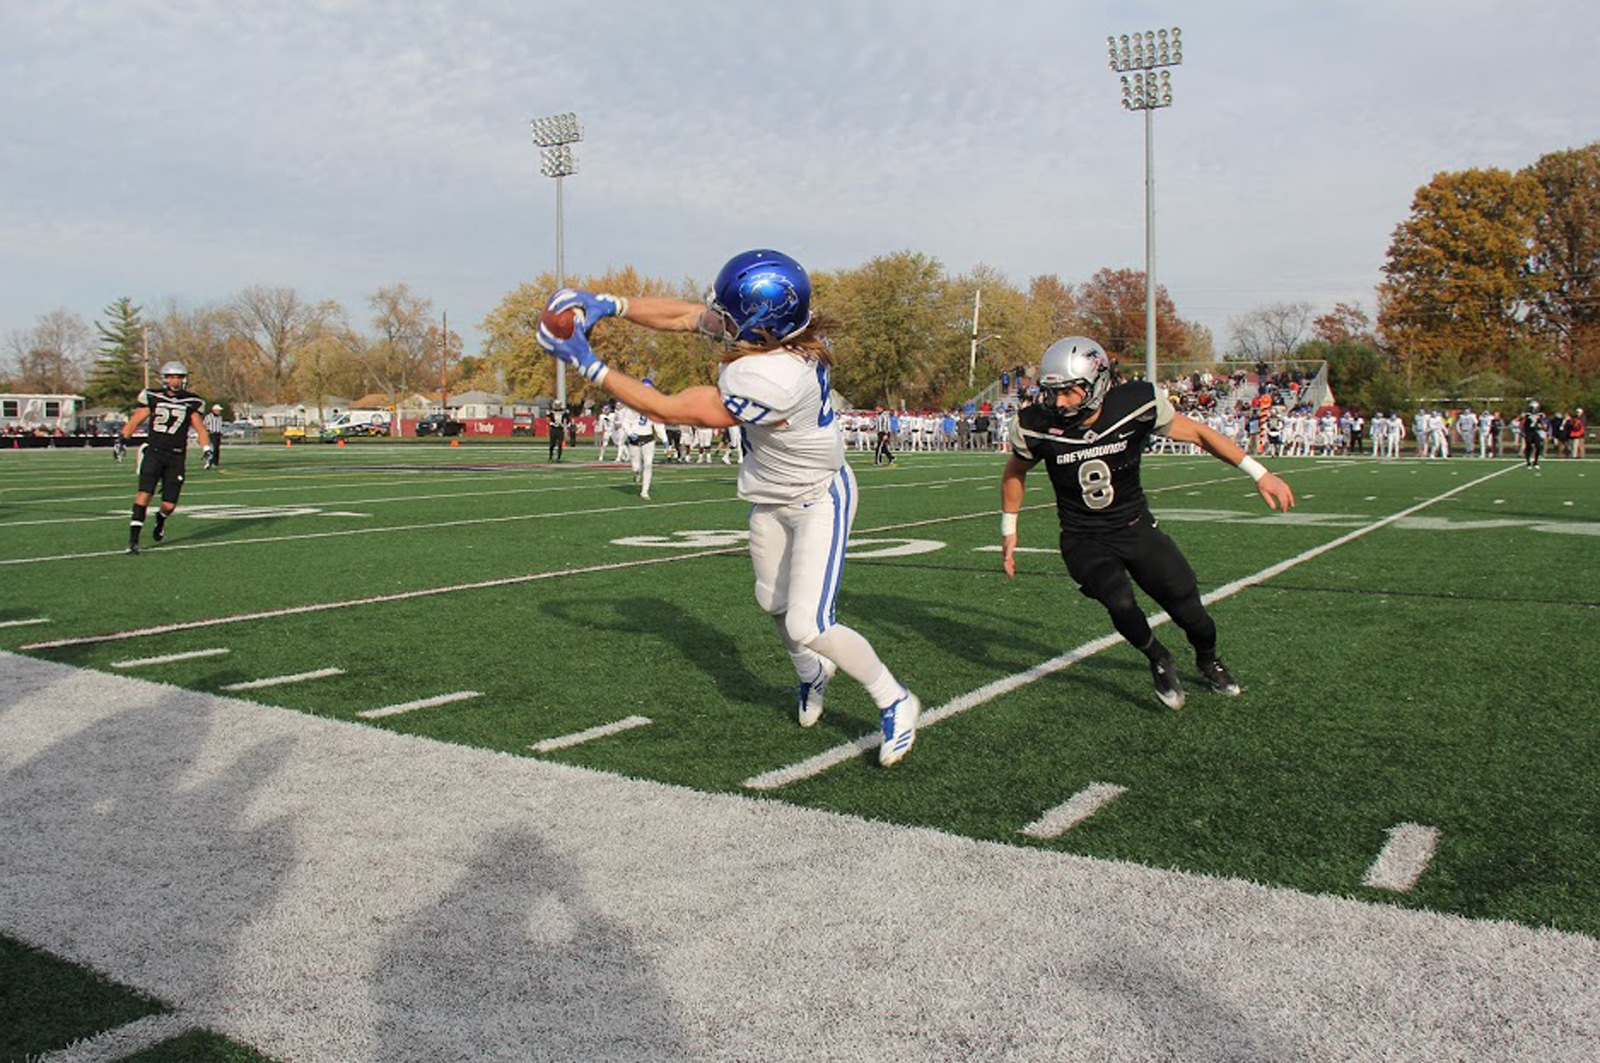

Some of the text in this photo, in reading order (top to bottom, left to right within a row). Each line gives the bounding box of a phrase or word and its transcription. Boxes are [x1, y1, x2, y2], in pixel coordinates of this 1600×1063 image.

[153, 407, 187, 435] 27
[723, 394, 771, 424] 87
[1056, 440, 1128, 465] GREYHOUNDS
[1078, 459, 1114, 510] 8
